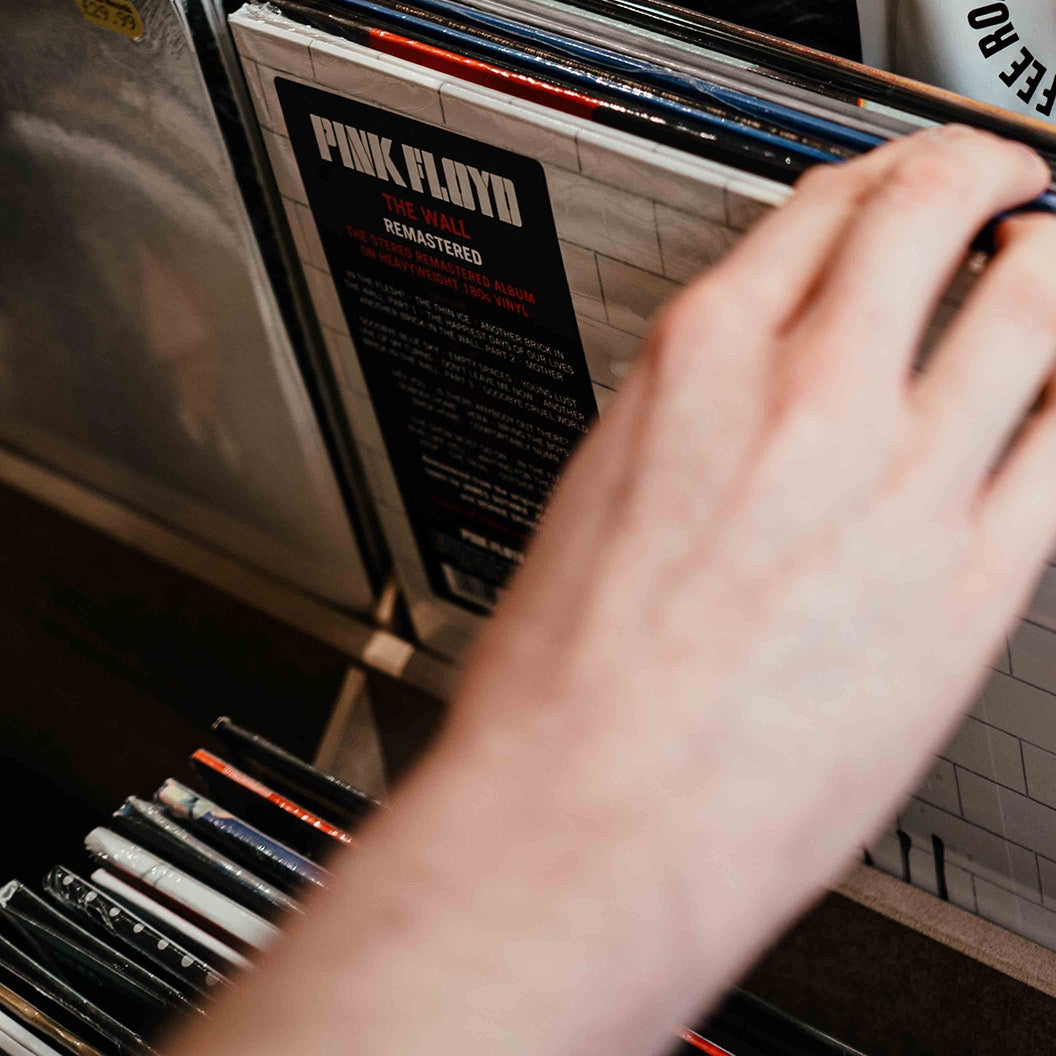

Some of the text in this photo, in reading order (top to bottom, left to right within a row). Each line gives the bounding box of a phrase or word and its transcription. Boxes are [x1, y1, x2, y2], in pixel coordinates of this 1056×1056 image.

[309, 113, 523, 228] PINK FLOYD
[382, 192, 471, 239] THE WALL
[383, 217, 483, 266] REMASTERED
[379, 249, 459, 291] HEAVYWEIGHT
[494, 294, 530, 318] VINYL
[415, 249, 491, 288] REMASTERED
[493, 280, 536, 304] ALBUM
[480, 321, 521, 343] ANOTHER
[523, 337, 552, 355] BRICK
[554, 349, 565, 360] IN
[488, 335, 512, 351] DAYS
[513, 345, 524, 355] OF
[526, 349, 546, 362] OUR
[548, 357, 575, 375] LIVES
[485, 344, 507, 360] PART
[509, 353, 516, 364] 2
[525, 360, 564, 381] MOTHER
[543, 399, 585, 421] ANOTHER
[554, 392, 577, 408] LUST
